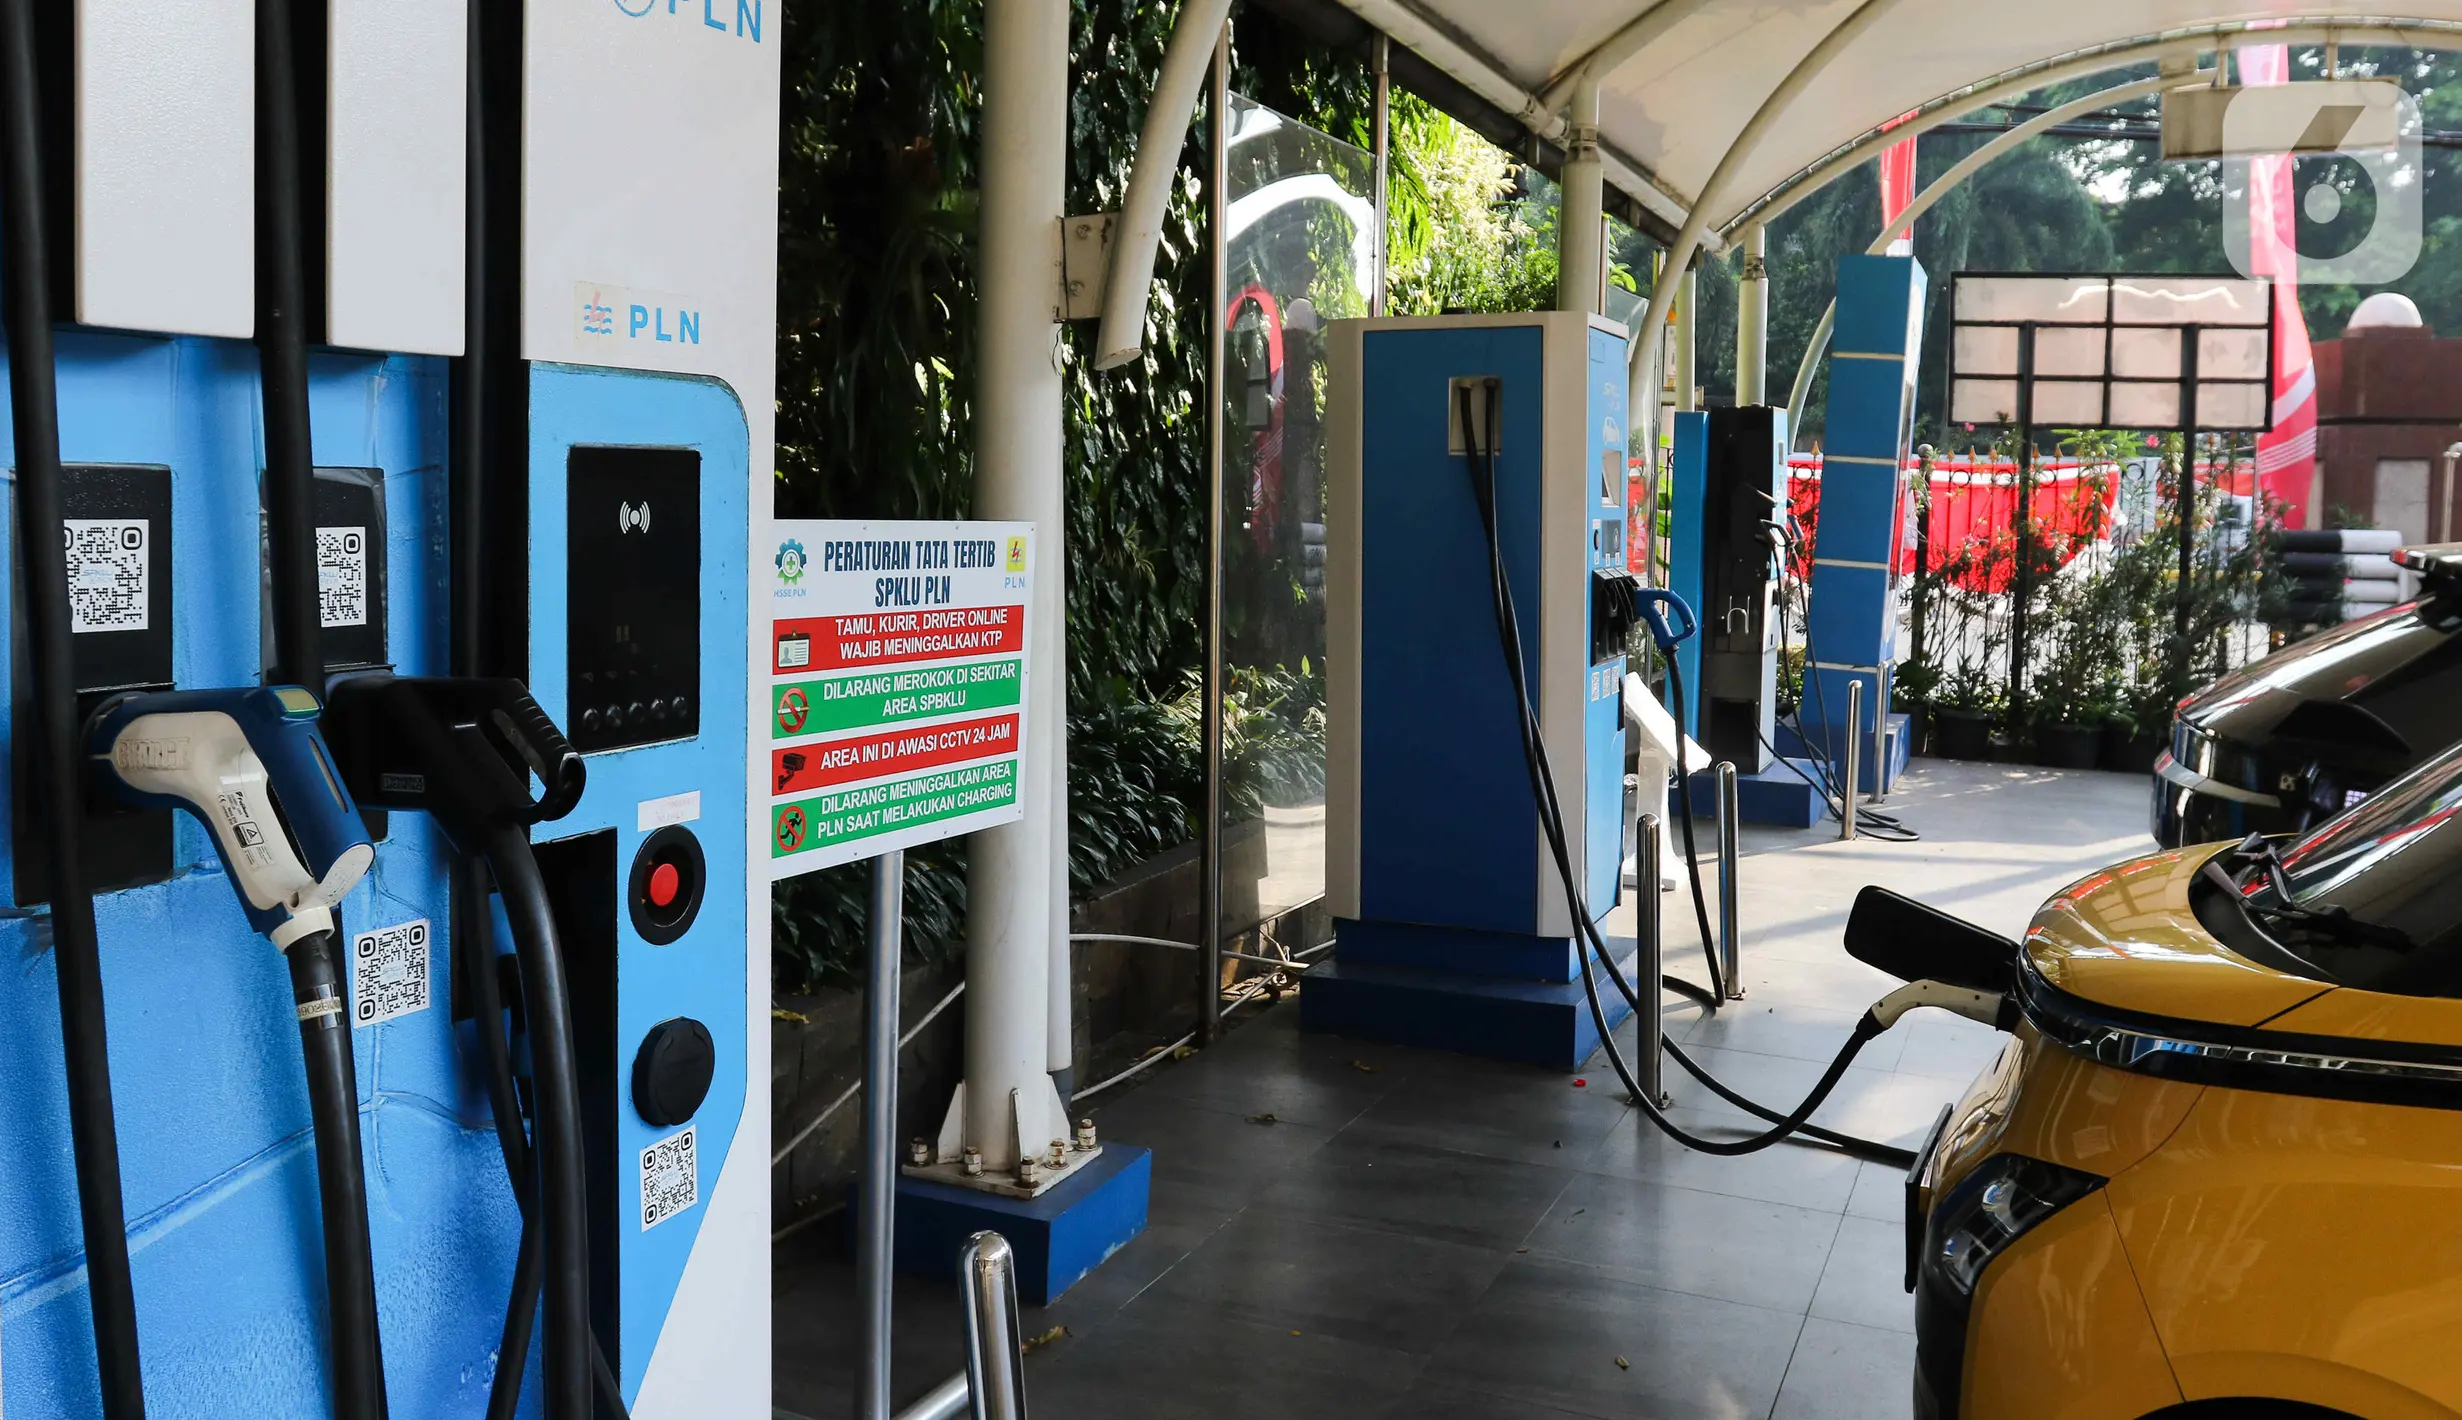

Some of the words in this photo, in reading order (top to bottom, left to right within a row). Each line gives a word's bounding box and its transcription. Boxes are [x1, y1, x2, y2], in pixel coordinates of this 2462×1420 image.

[629, 304, 700, 345] PLN
[824, 540, 911, 572] PERATURAN
[916, 540, 949, 570] TATA
[953, 540, 996, 569] TERTIB
[792, 587, 807, 597] PLN
[875, 576, 921, 608] SPKLU
[925, 575, 951, 605] PLN
[1004, 576, 1027, 589] PLN
[835, 616, 876, 637] TAMU,
[879, 614, 921, 633] KURIR,
[923, 610, 966, 630] DRIVER
[967, 608, 1008, 627] ONLINE
[840, 639, 882, 660] WAJIB
[884, 632, 979, 656] MENINGGALKAN
[981, 630, 1003, 647] KTP
[823, 676, 891, 700] DILARANG
[893, 669, 955, 692] MEROKOK
[957, 667, 968, 684] DI
[970, 662, 1016, 683] SEKITAR
[882, 696, 917, 717] AREA
[919, 689, 967, 712] SPBKLU
[820, 746, 860, 770] AREA
[862, 744, 879, 764] INI
[882, 740, 894, 760] DI
[896, 735, 937, 757] AWASI
[939, 728, 972, 750] CCTV
[972, 726, 986, 745] 24
[986, 722, 1011, 741] JAM
[821, 786, 887, 815] DILARANG
[889, 770, 980, 799] MENINGGALKAN
[981, 762, 1011, 782] AREA
[817, 817, 844, 839] PLN
[846, 811, 880, 832] SAAT
[882, 794, 956, 824] MELAKUKAN
[957, 782, 1013, 808] CHARGING
